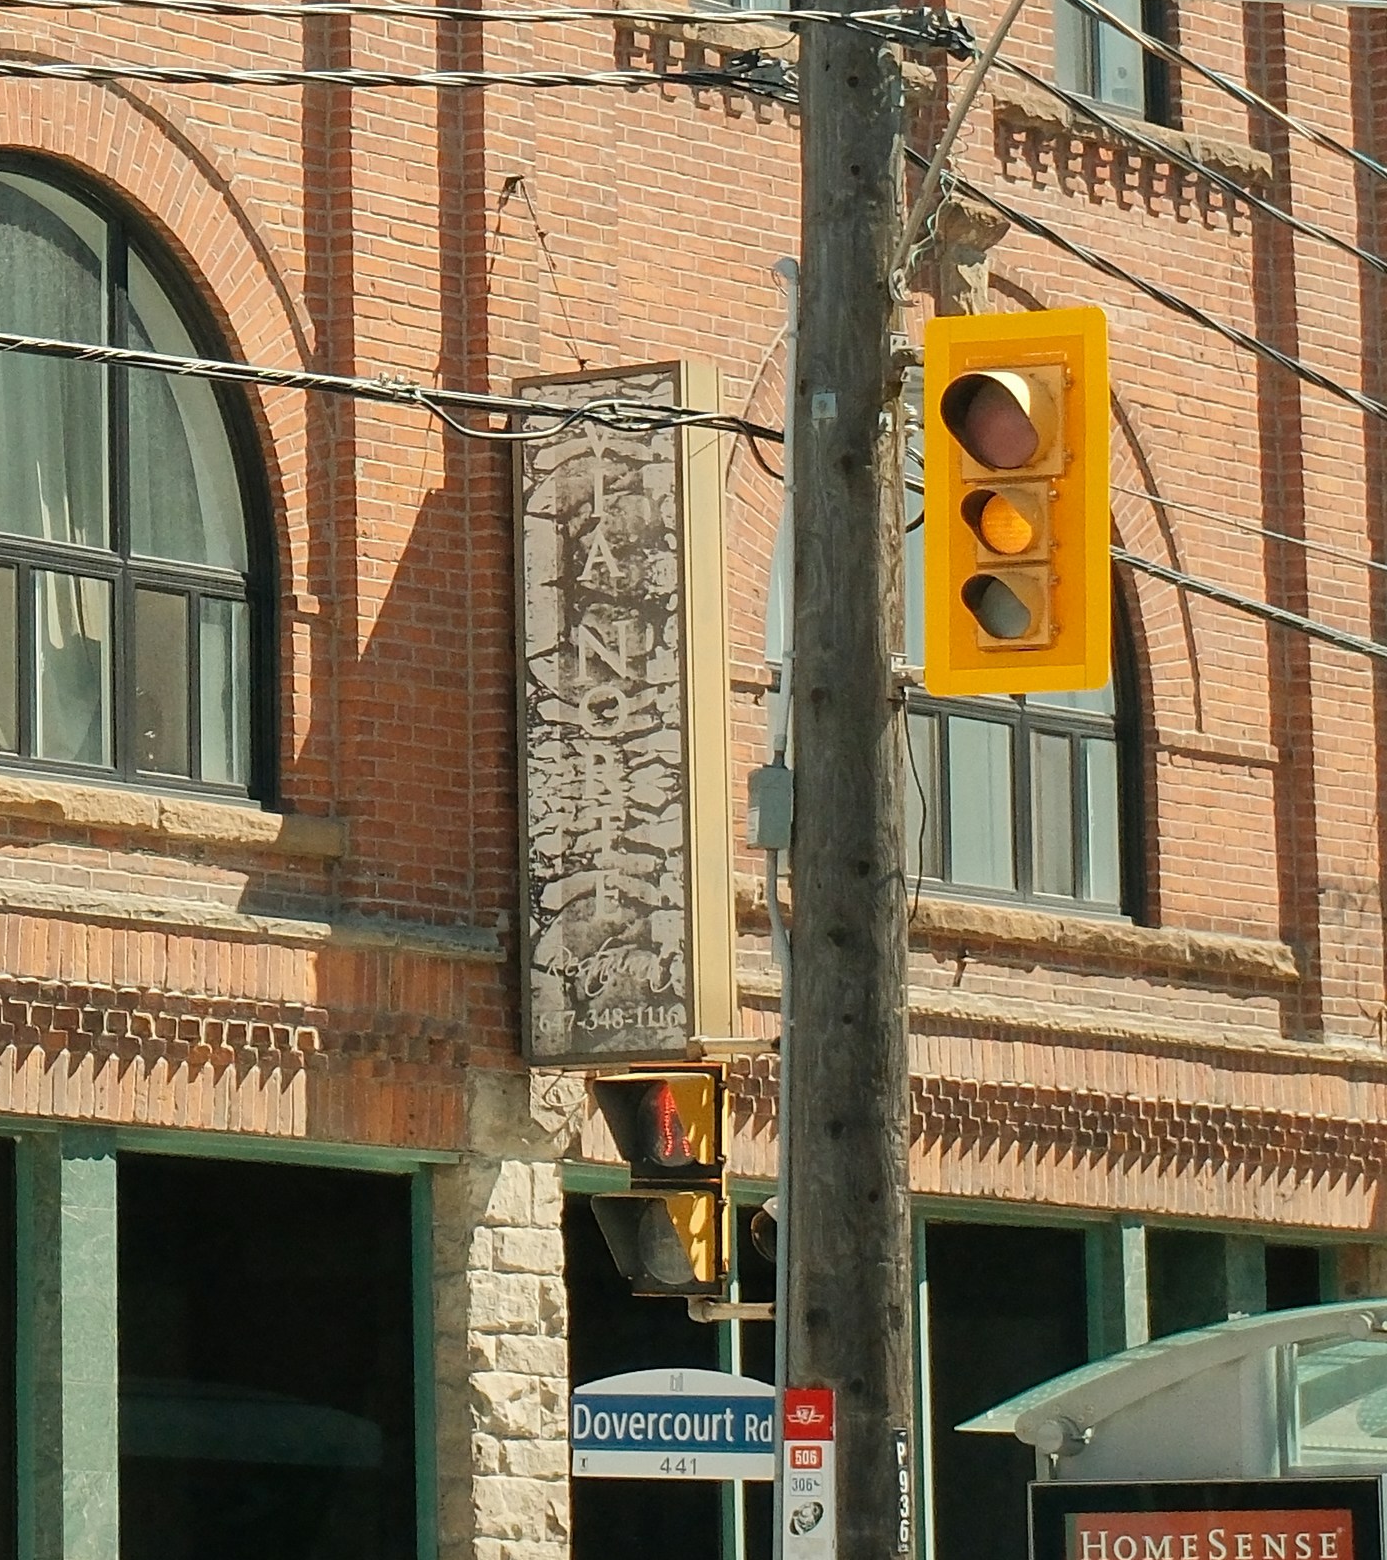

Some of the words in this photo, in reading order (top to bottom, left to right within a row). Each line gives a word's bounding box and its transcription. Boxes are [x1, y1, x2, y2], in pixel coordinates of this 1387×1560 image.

[577, 617, 631, 923] NORTE
[573, 1403, 735, 1442] Dovercourt
[744, 1414, 773, 1442] Rd
[659, 1457, 697, 1476] 441
[794, 1449, 818, 1465] 506
[791, 1477, 813, 1492] 306
